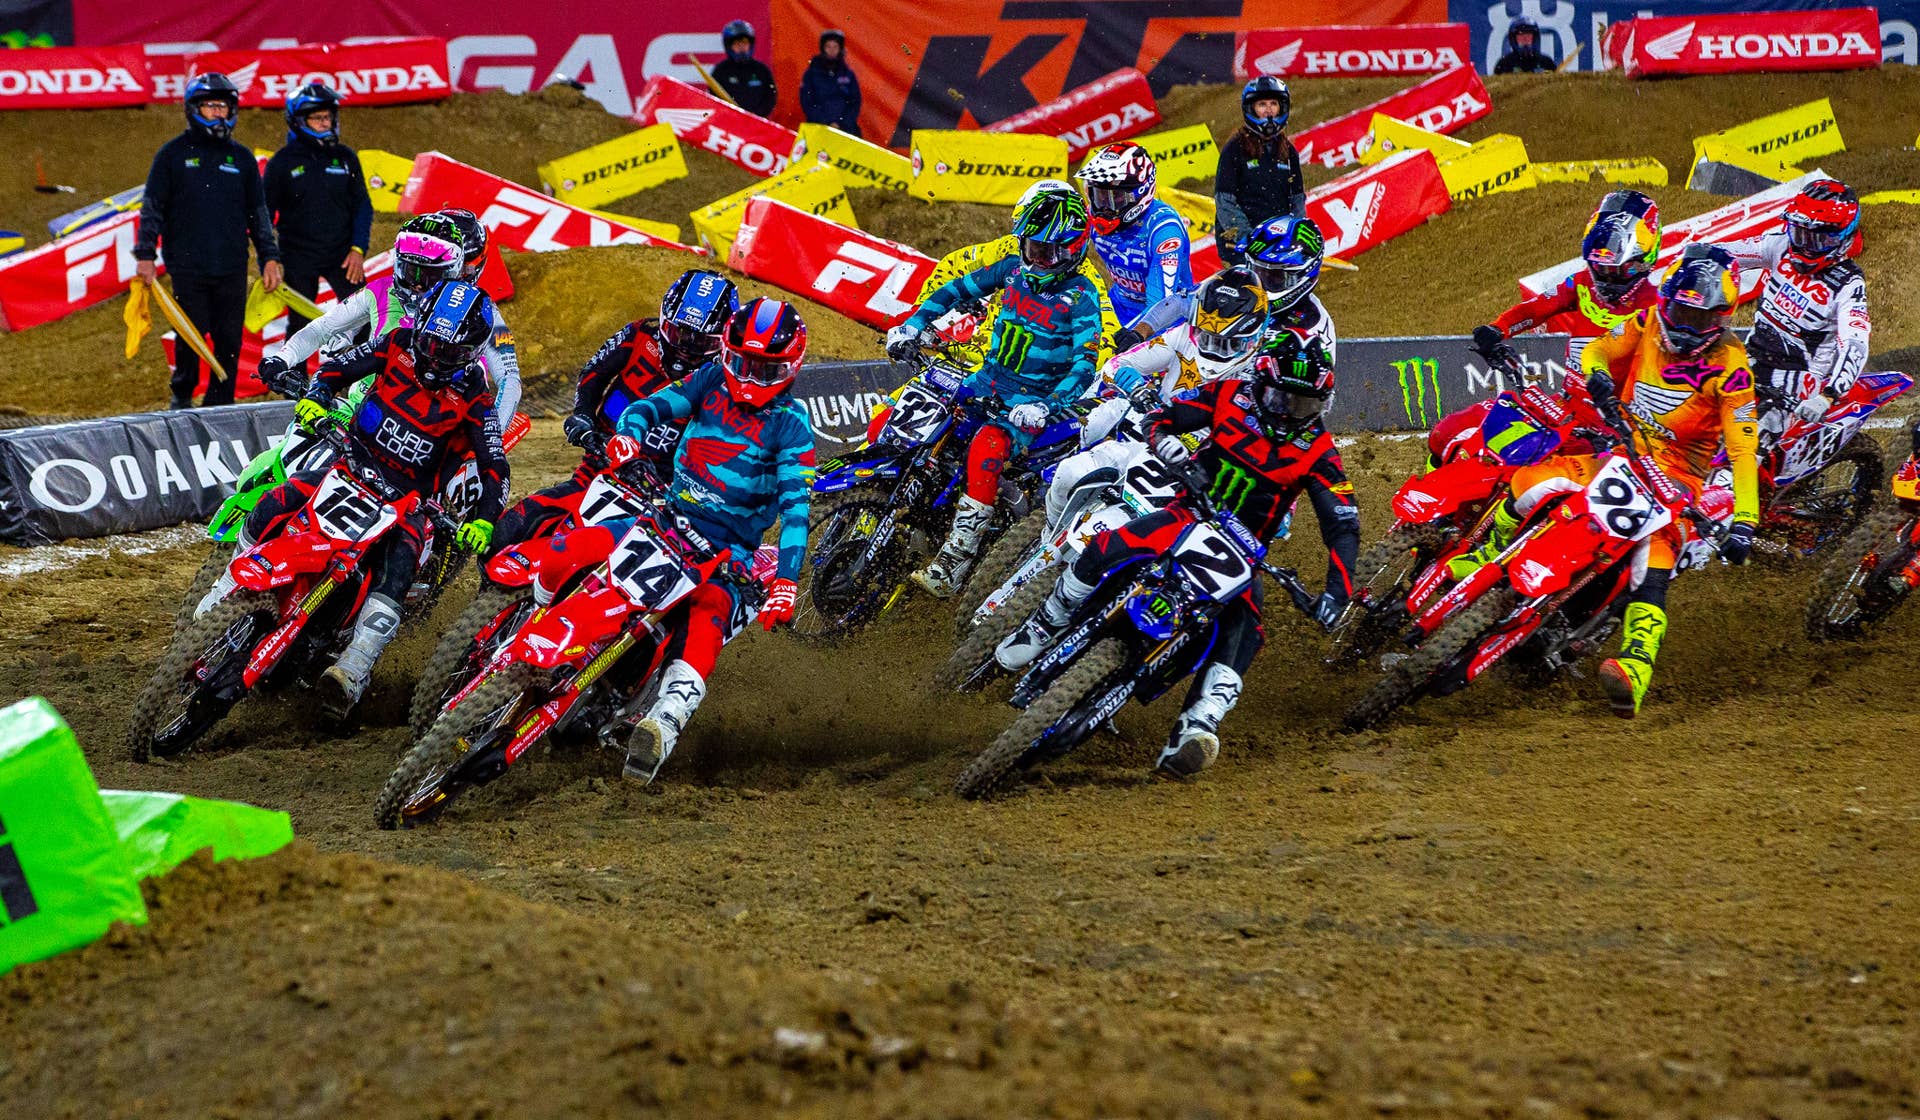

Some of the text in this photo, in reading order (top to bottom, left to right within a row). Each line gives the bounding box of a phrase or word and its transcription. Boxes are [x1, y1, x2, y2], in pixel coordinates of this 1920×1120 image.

[1304, 47, 1463, 74] HONDA
[1698, 32, 1875, 59] HONDA
[0, 67, 144, 95] ONDA
[261, 64, 447, 98] HONDA
[1062, 102, 1155, 151] NDA
[582, 144, 674, 185] DUNLOP
[955, 161, 1063, 179] DUNLOP
[1153, 140, 1212, 163] NLOP
[837, 156, 909, 191] DUNLO
[1451, 164, 1527, 200] UNLOP
[1362, 181, 1387, 240] RACING
[812, 240, 918, 318] FL
[1782, 284, 1808, 308] LIQUI
[1776, 294, 1802, 318] MOLY
[890, 390, 950, 440] 32
[375, 428, 431, 466] LOCK
[382, 416, 434, 455] QUAD
[1213, 416, 1300, 473] FLY
[1487, 420, 1538, 454] 1
[110, 434, 287, 500] OAKL
[313, 485, 380, 538] 12
[1590, 477, 1650, 537] 96
[611, 539, 684, 605] 14
[1174, 535, 1246, 599] 2
[1088, 680, 1136, 730] DUNLOP
